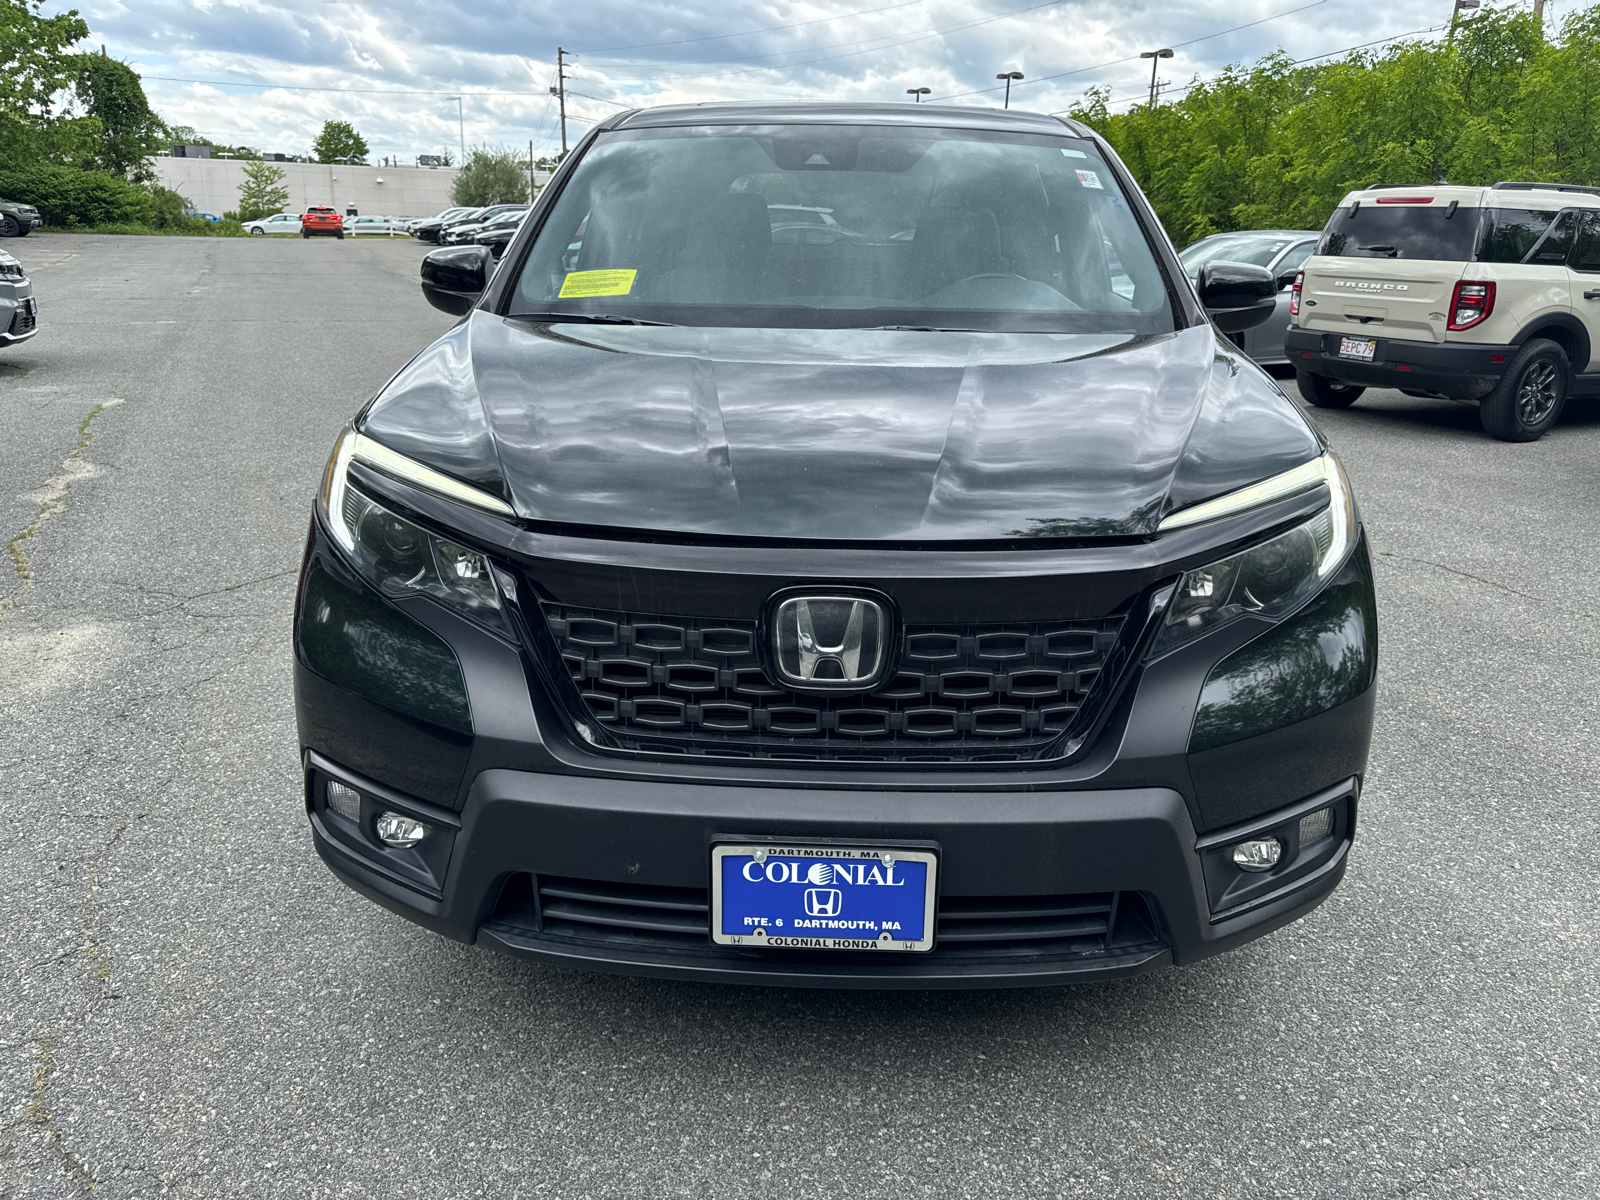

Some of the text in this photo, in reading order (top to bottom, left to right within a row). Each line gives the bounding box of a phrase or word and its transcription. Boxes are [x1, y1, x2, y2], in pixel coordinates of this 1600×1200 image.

[1335, 281, 1409, 291] BRONCO
[742, 860, 905, 886] COLONIAL
[743, 917, 902, 931] RTE. 6 DARTMOUTH, MA
[766, 937, 879, 949] COLONIAL HONDA
